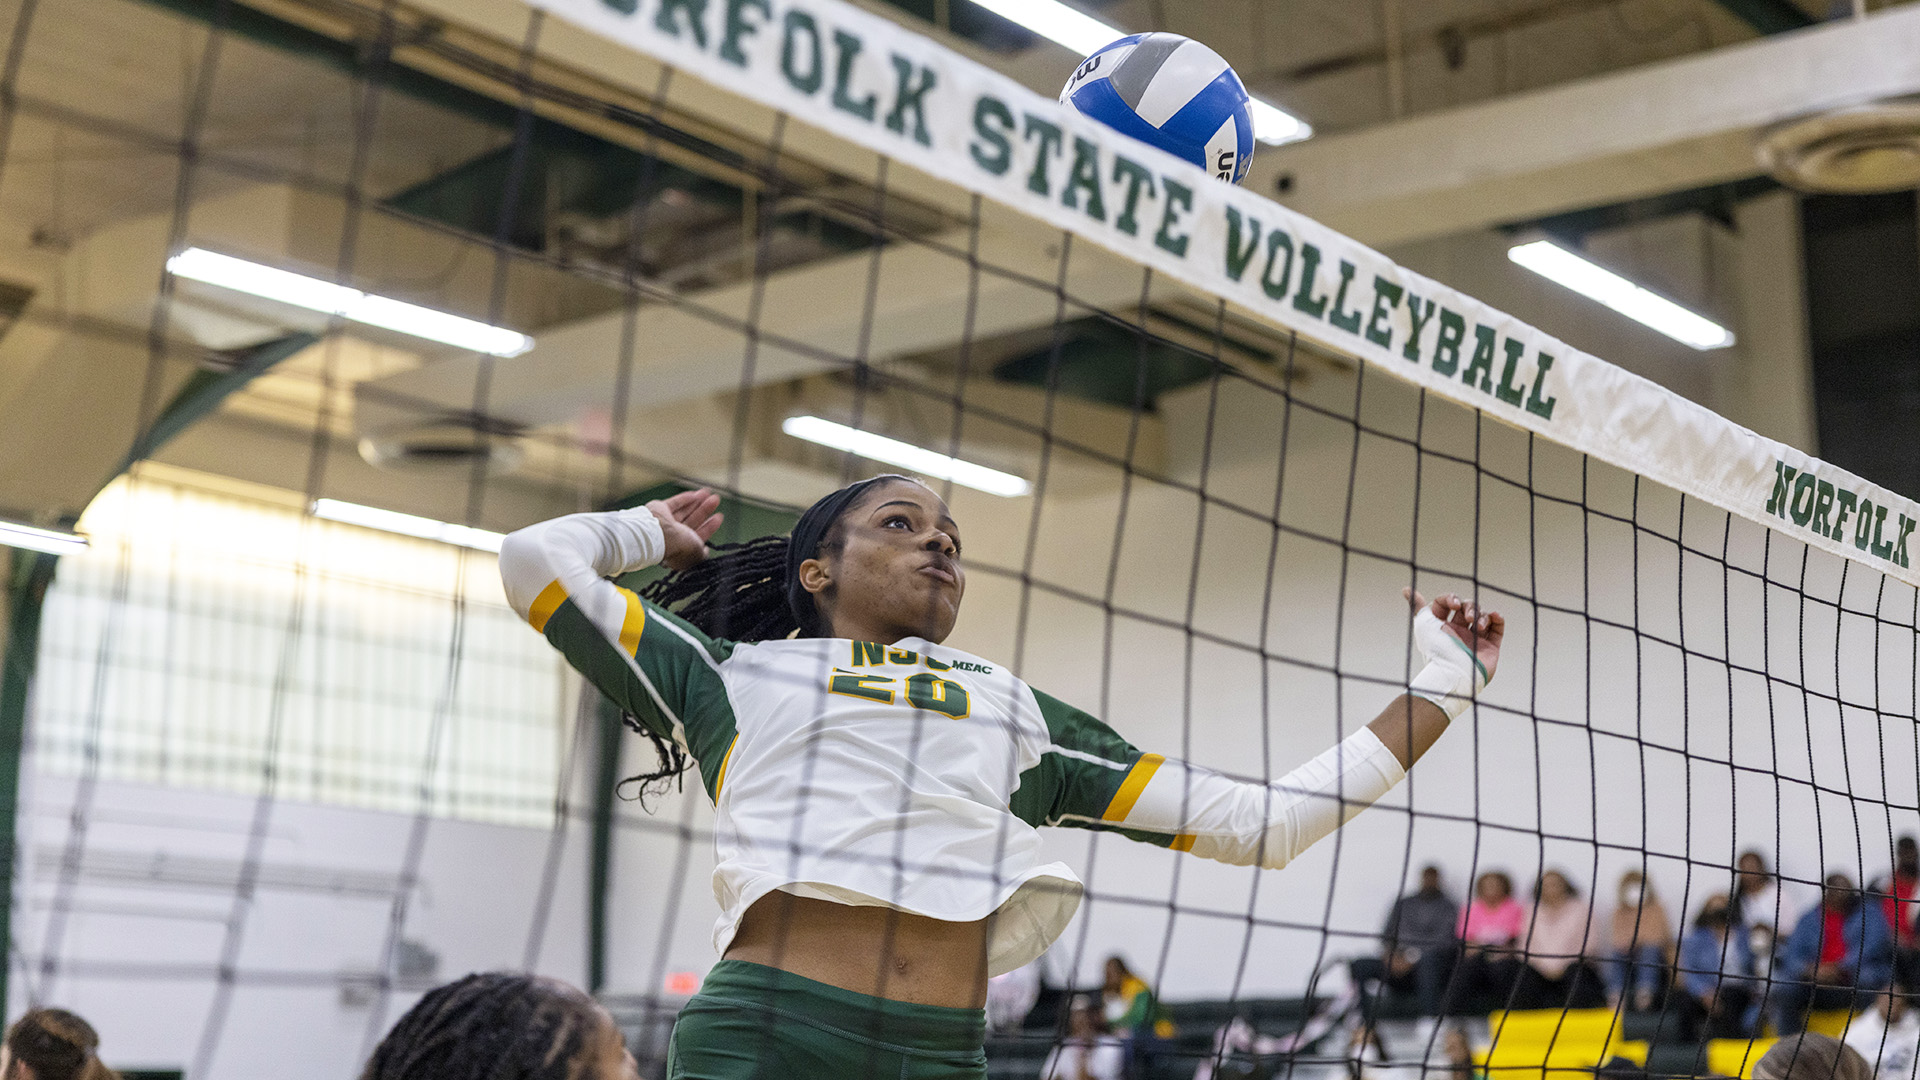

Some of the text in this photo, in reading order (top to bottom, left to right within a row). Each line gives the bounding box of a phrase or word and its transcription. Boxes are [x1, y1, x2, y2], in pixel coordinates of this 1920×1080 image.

[969, 93, 1194, 259] STATE
[1225, 203, 1557, 421] VOLLEYBALL
[1765, 459, 1917, 570] NORFOLK
[951, 658, 993, 676] MEAC
